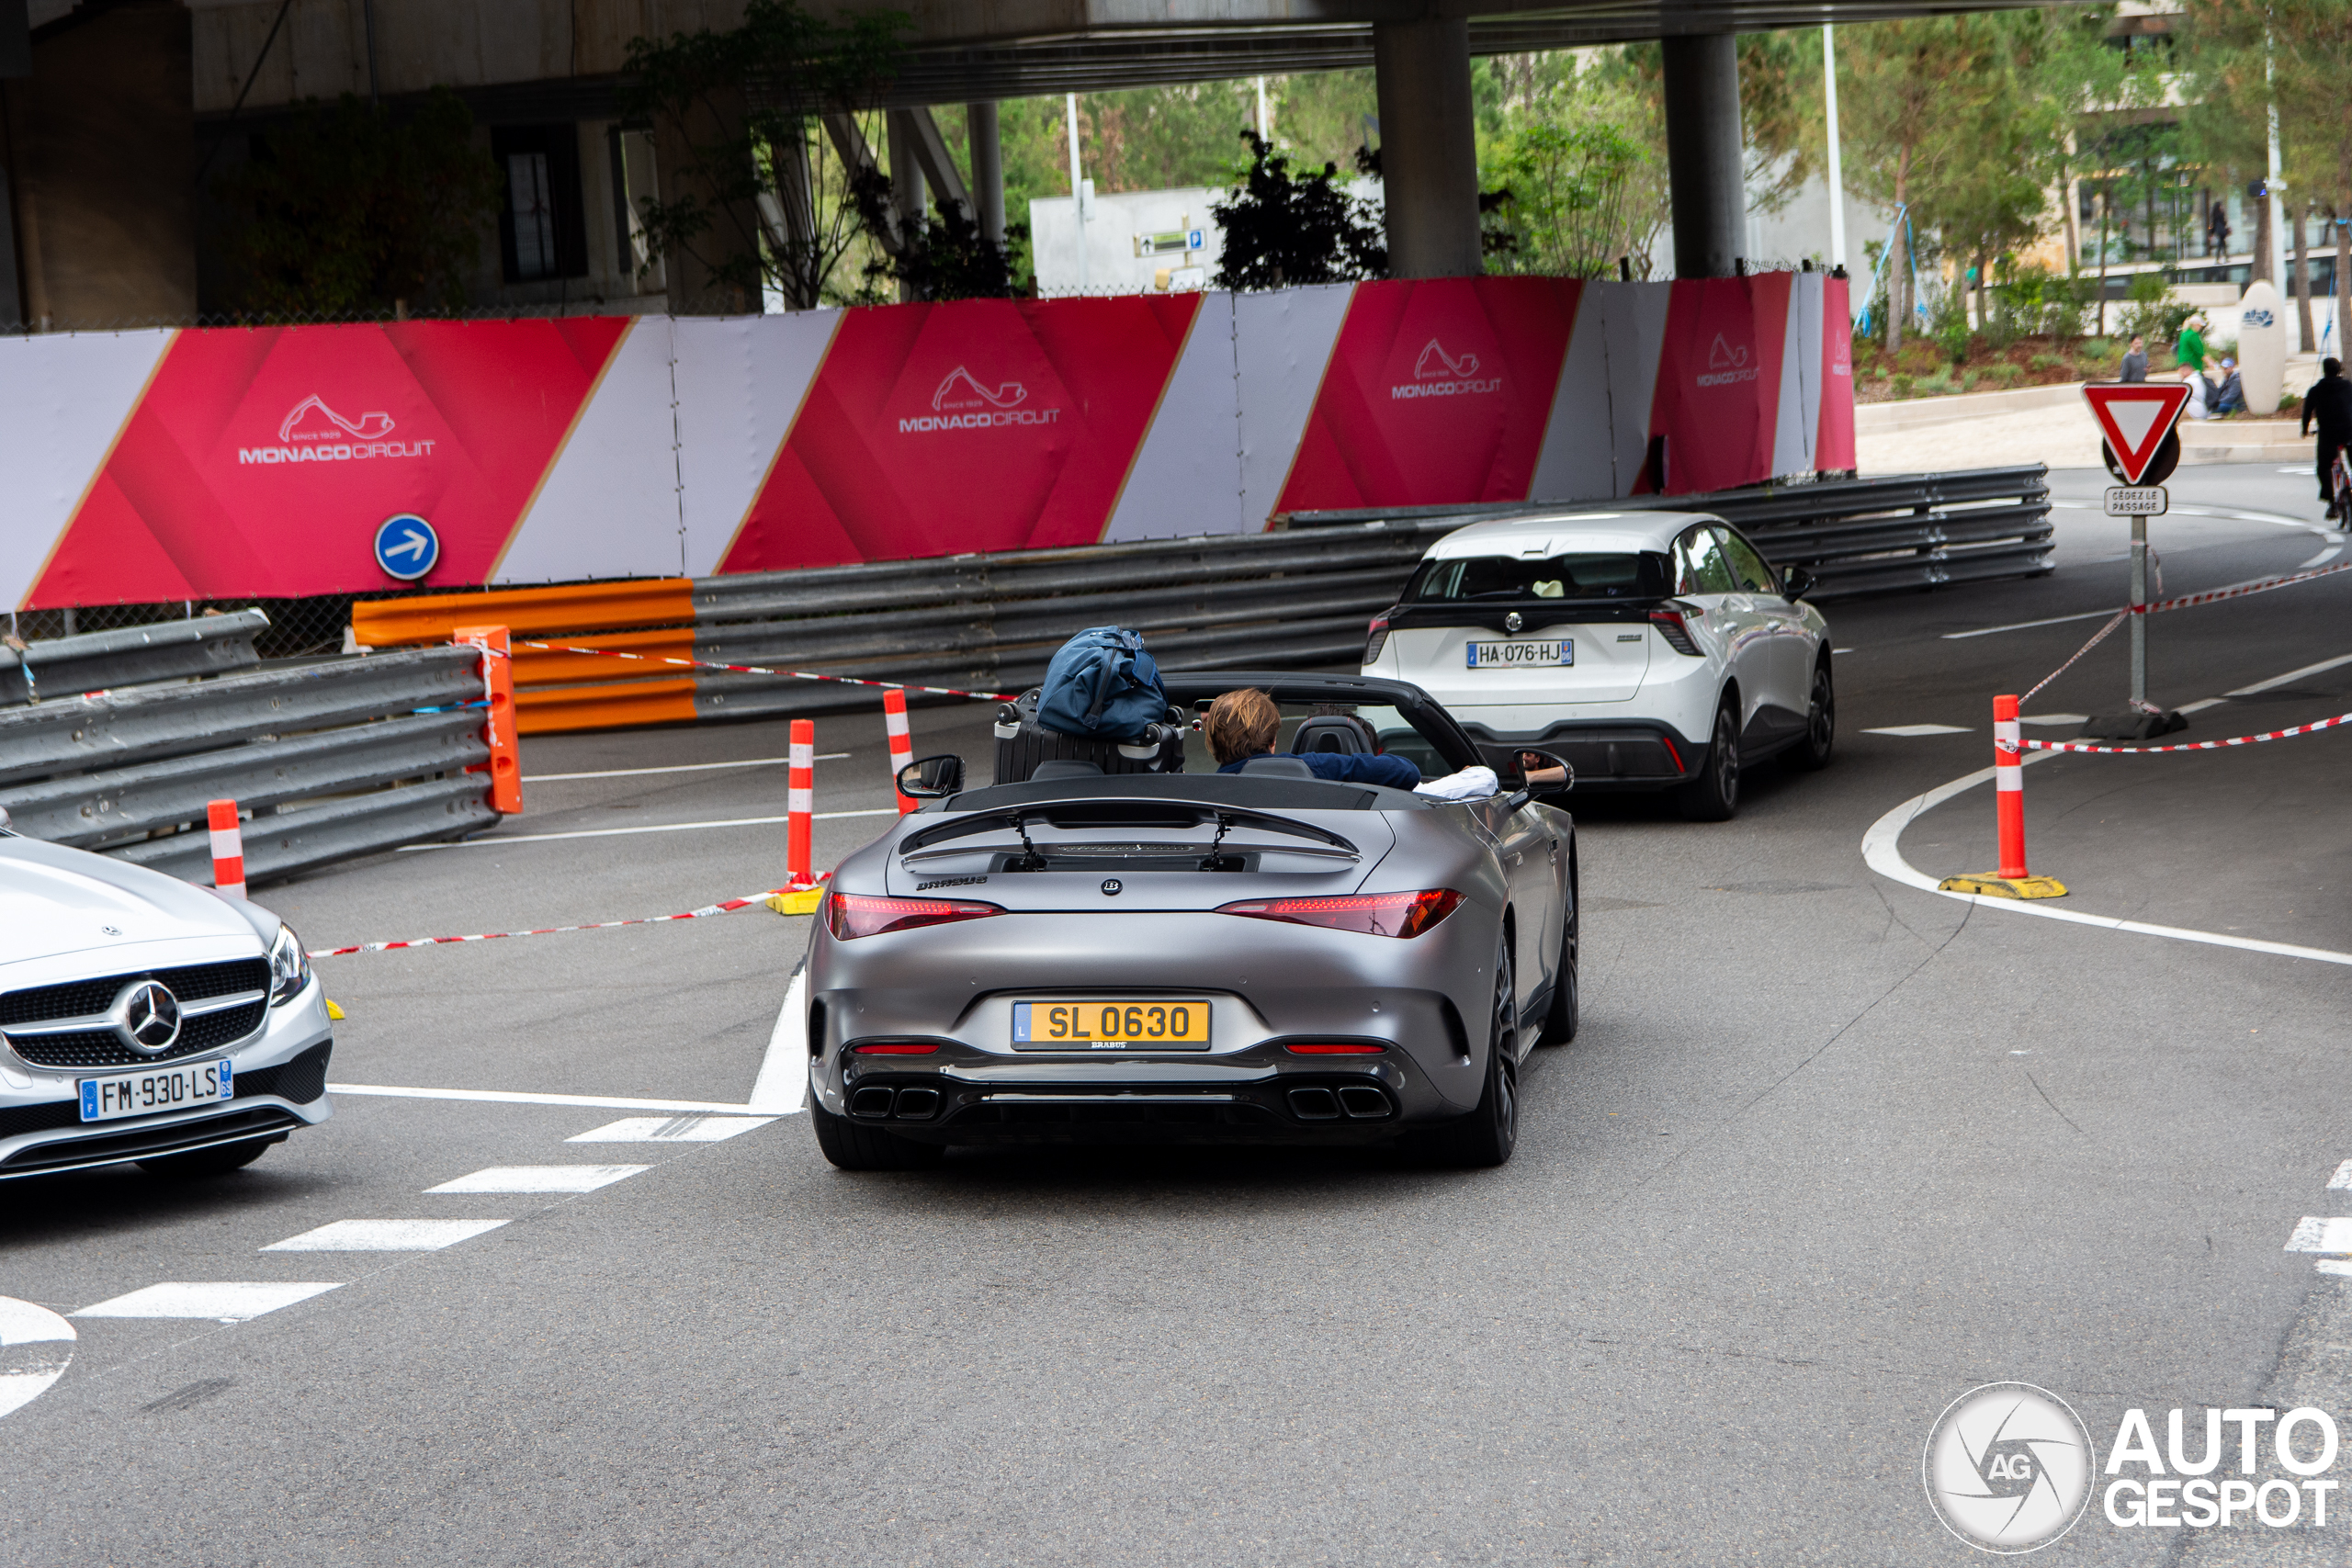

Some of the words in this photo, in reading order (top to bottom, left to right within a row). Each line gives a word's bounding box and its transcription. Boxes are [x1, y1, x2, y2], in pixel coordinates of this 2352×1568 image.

[292, 432, 319, 441] SINCE
[320, 429, 341, 439] 1929
[2112, 490, 2143, 501] CÉDEZ
[2145, 491, 2157, 501] LE
[2112, 502, 2157, 512] PASSAGE
[1479, 644, 1560, 662] HA-076-HJ
[916, 875, 988, 891] BRABUS
[1049, 1007, 1091, 1038] SL
[1102, 1007, 1189, 1037] 0630
[1018, 1026, 1025, 1037] L
[1091, 1041, 1127, 1049] BRABUS
[102, 1067, 217, 1112] FM-930-LS
[220, 1079, 232, 1096] 69
[86, 1103, 94, 1113] F
